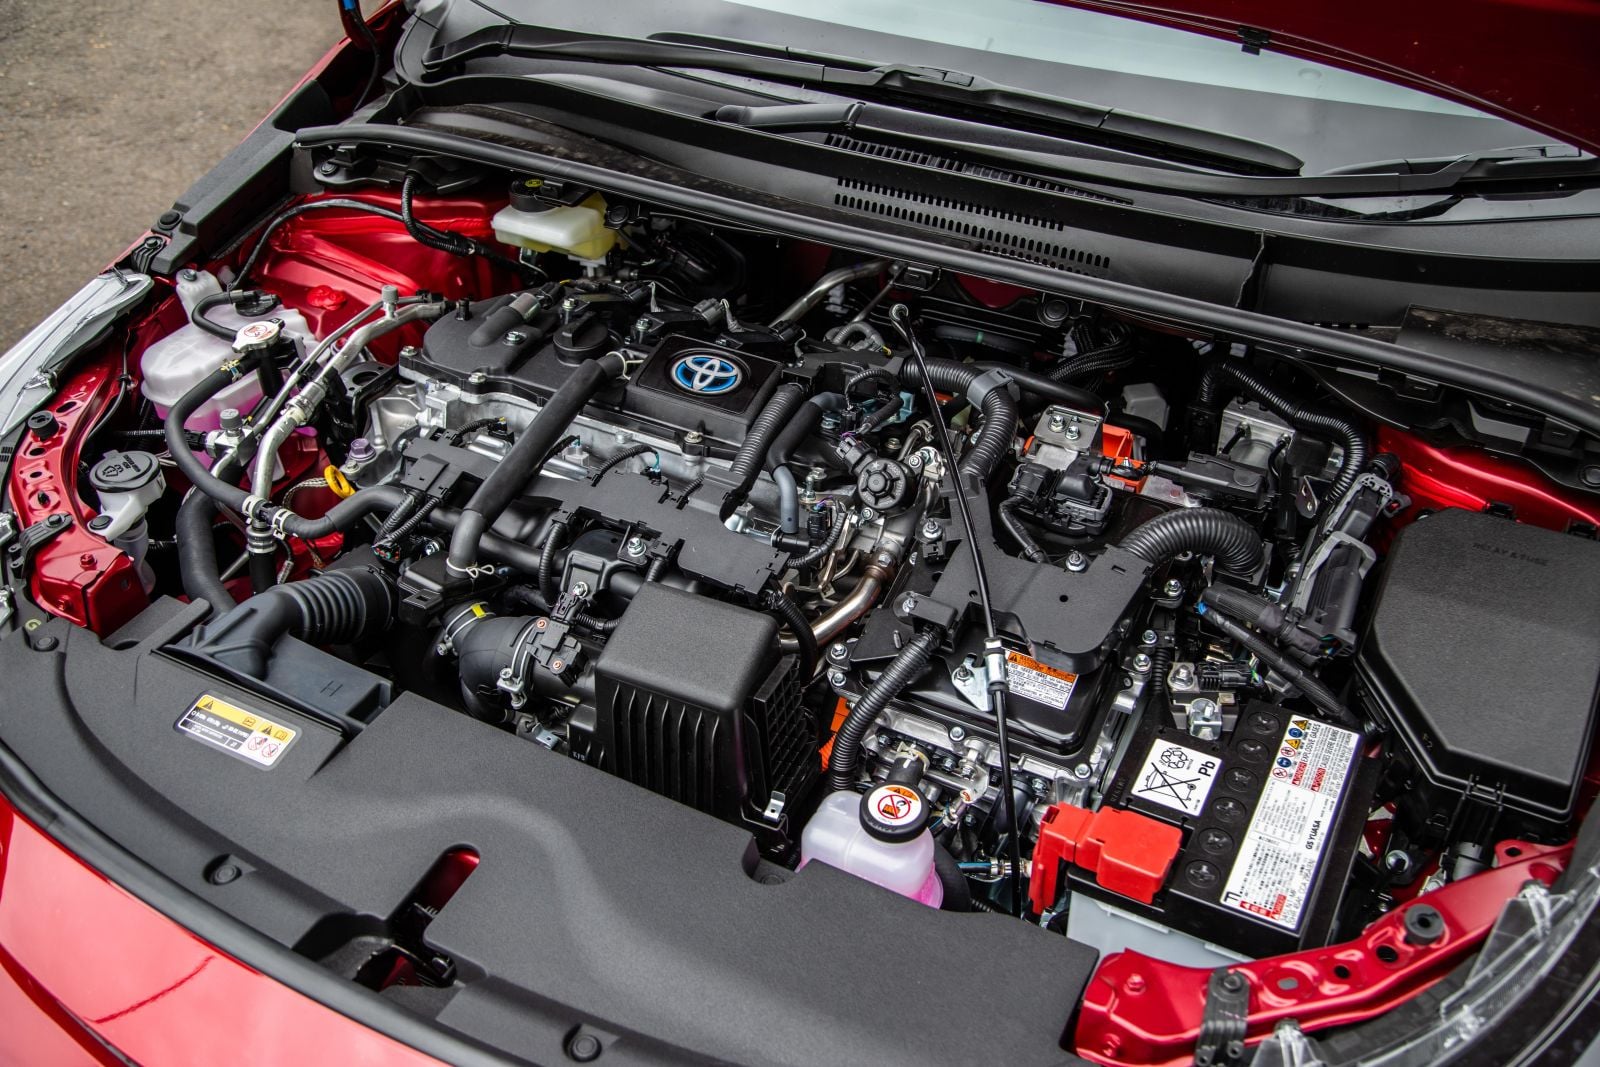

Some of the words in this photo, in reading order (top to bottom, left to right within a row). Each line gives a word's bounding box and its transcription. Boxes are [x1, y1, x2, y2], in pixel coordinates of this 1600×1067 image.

[1301, 740, 1315, 762] EXPLOSIVE
[1310, 723, 1320, 739] GASES
[1198, 760, 1216, 777] Pb
[1308, 820, 1321, 841] YUASA
[1305, 840, 1314, 850] GS
